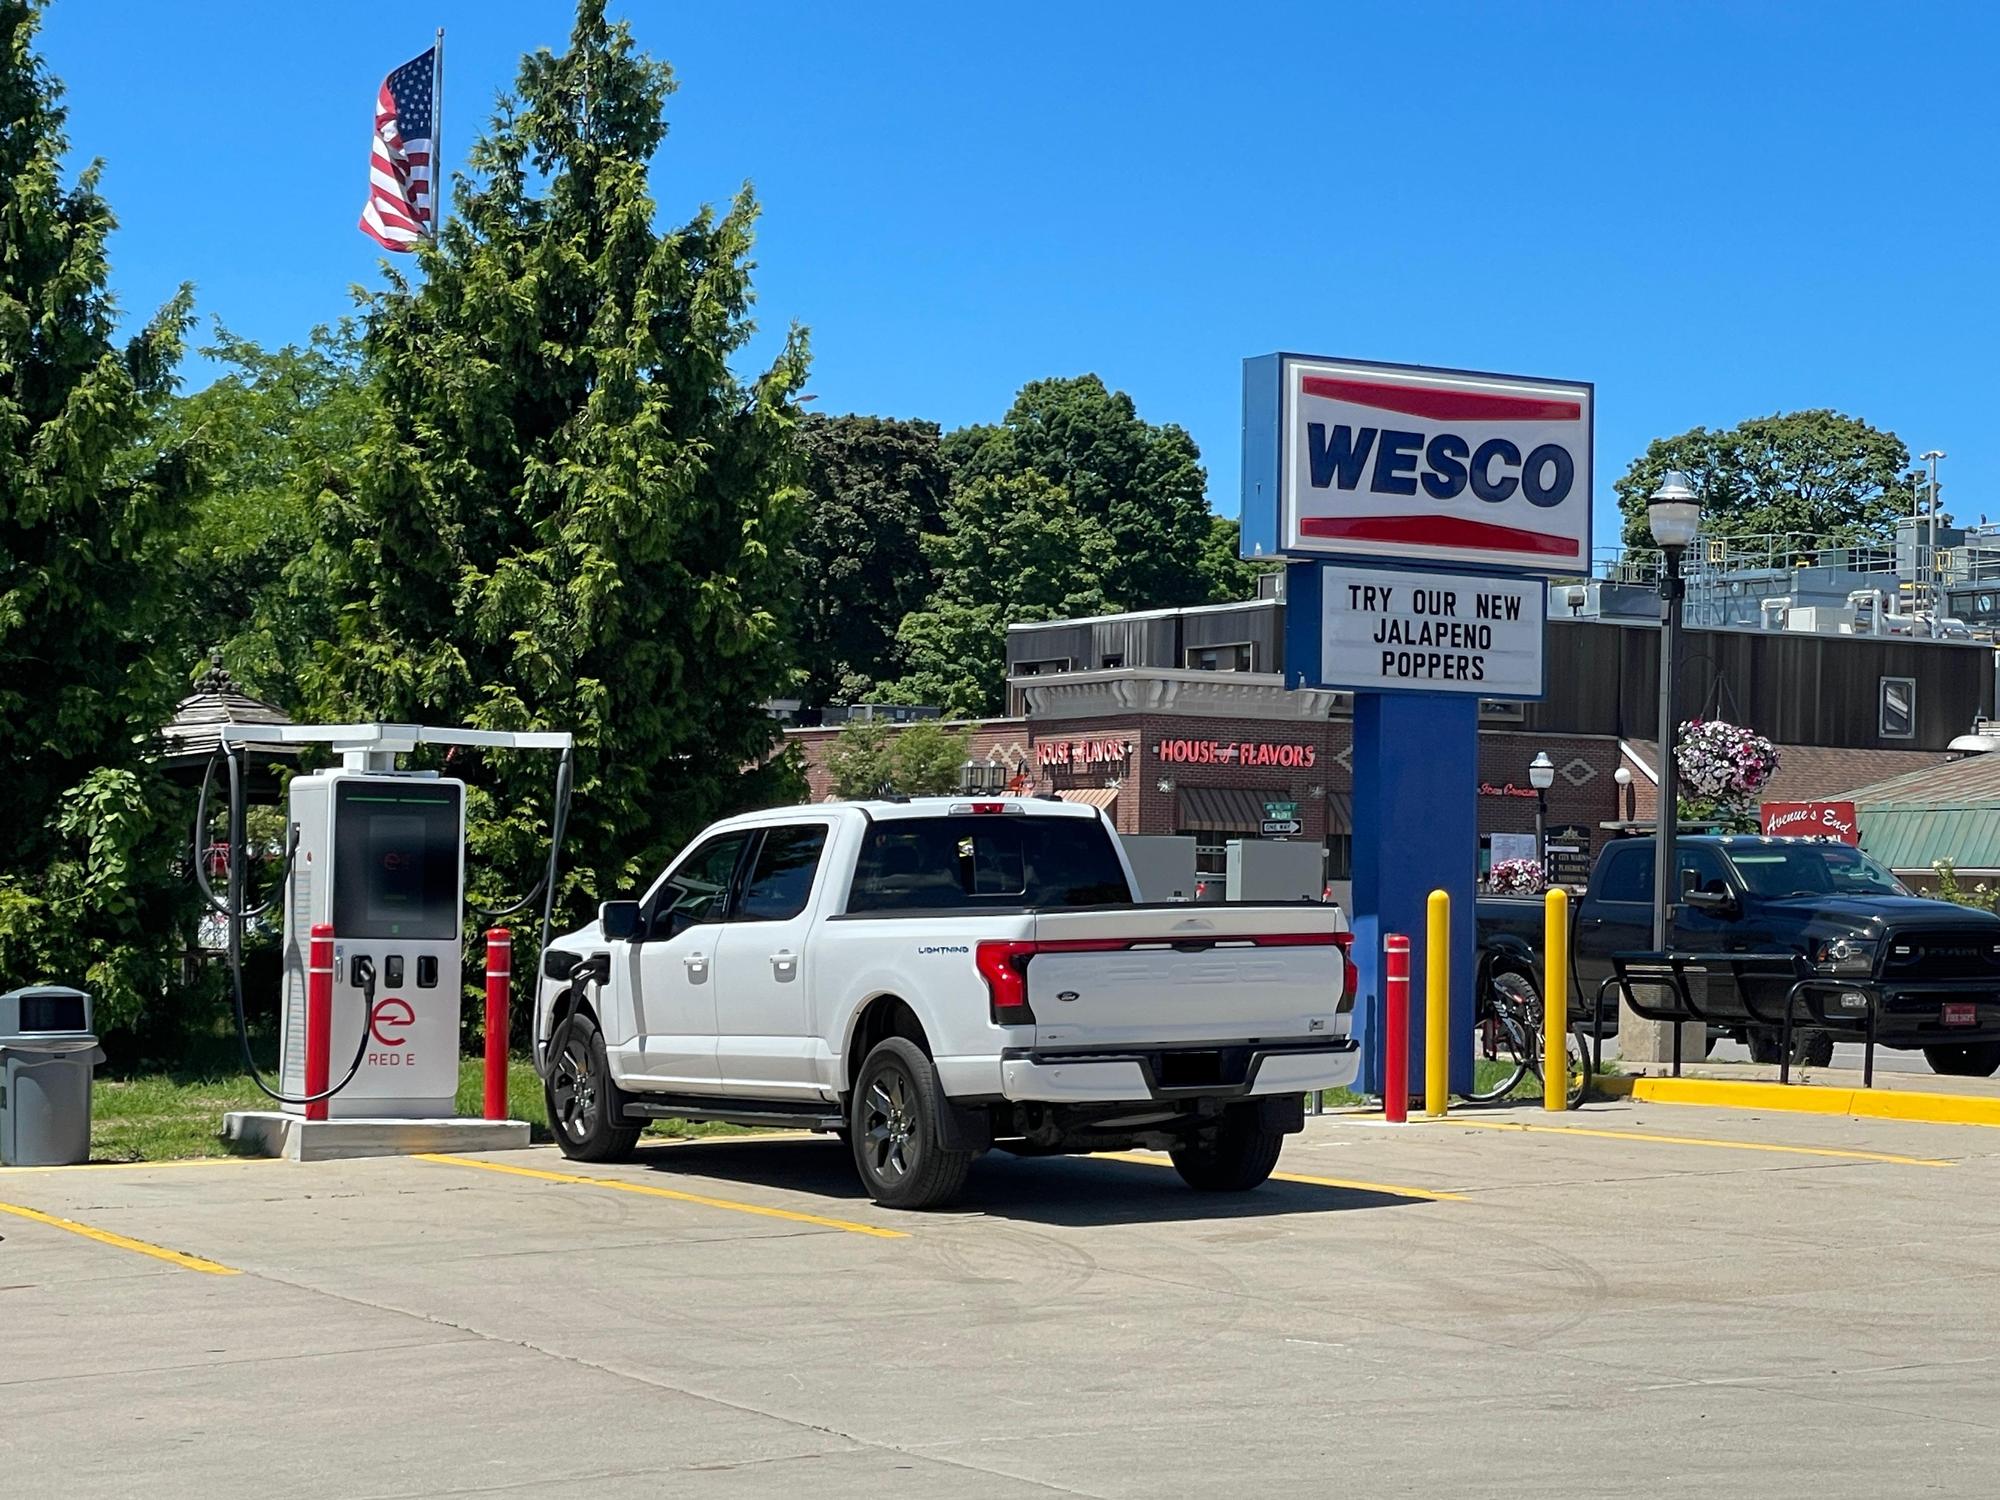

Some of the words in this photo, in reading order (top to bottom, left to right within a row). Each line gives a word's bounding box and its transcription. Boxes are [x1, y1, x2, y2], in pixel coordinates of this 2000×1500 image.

[1307, 422, 1574, 507] WESCO
[1348, 585, 1393, 612] TRY
[1413, 589, 1457, 617] OUR
[1476, 593, 1521, 621] NEW
[1373, 619, 1491, 650] JALAPENO
[1382, 651, 1485, 681] POPPERS
[1037, 742, 1069, 765] HOUSE
[1081, 740, 1125, 763] FLAVORS
[1160, 740, 1218, 763] HOUSE
[1219, 743, 1236, 764] of
[1240, 744, 1315, 767] FLAVORS
[1265, 823, 1277, 831] ONE
[1767, 804, 1818, 835] Avenue's
[1822, 809, 1852, 834] End
[368, 1053, 400, 1066] RED
[406, 1053, 416, 1066] E
